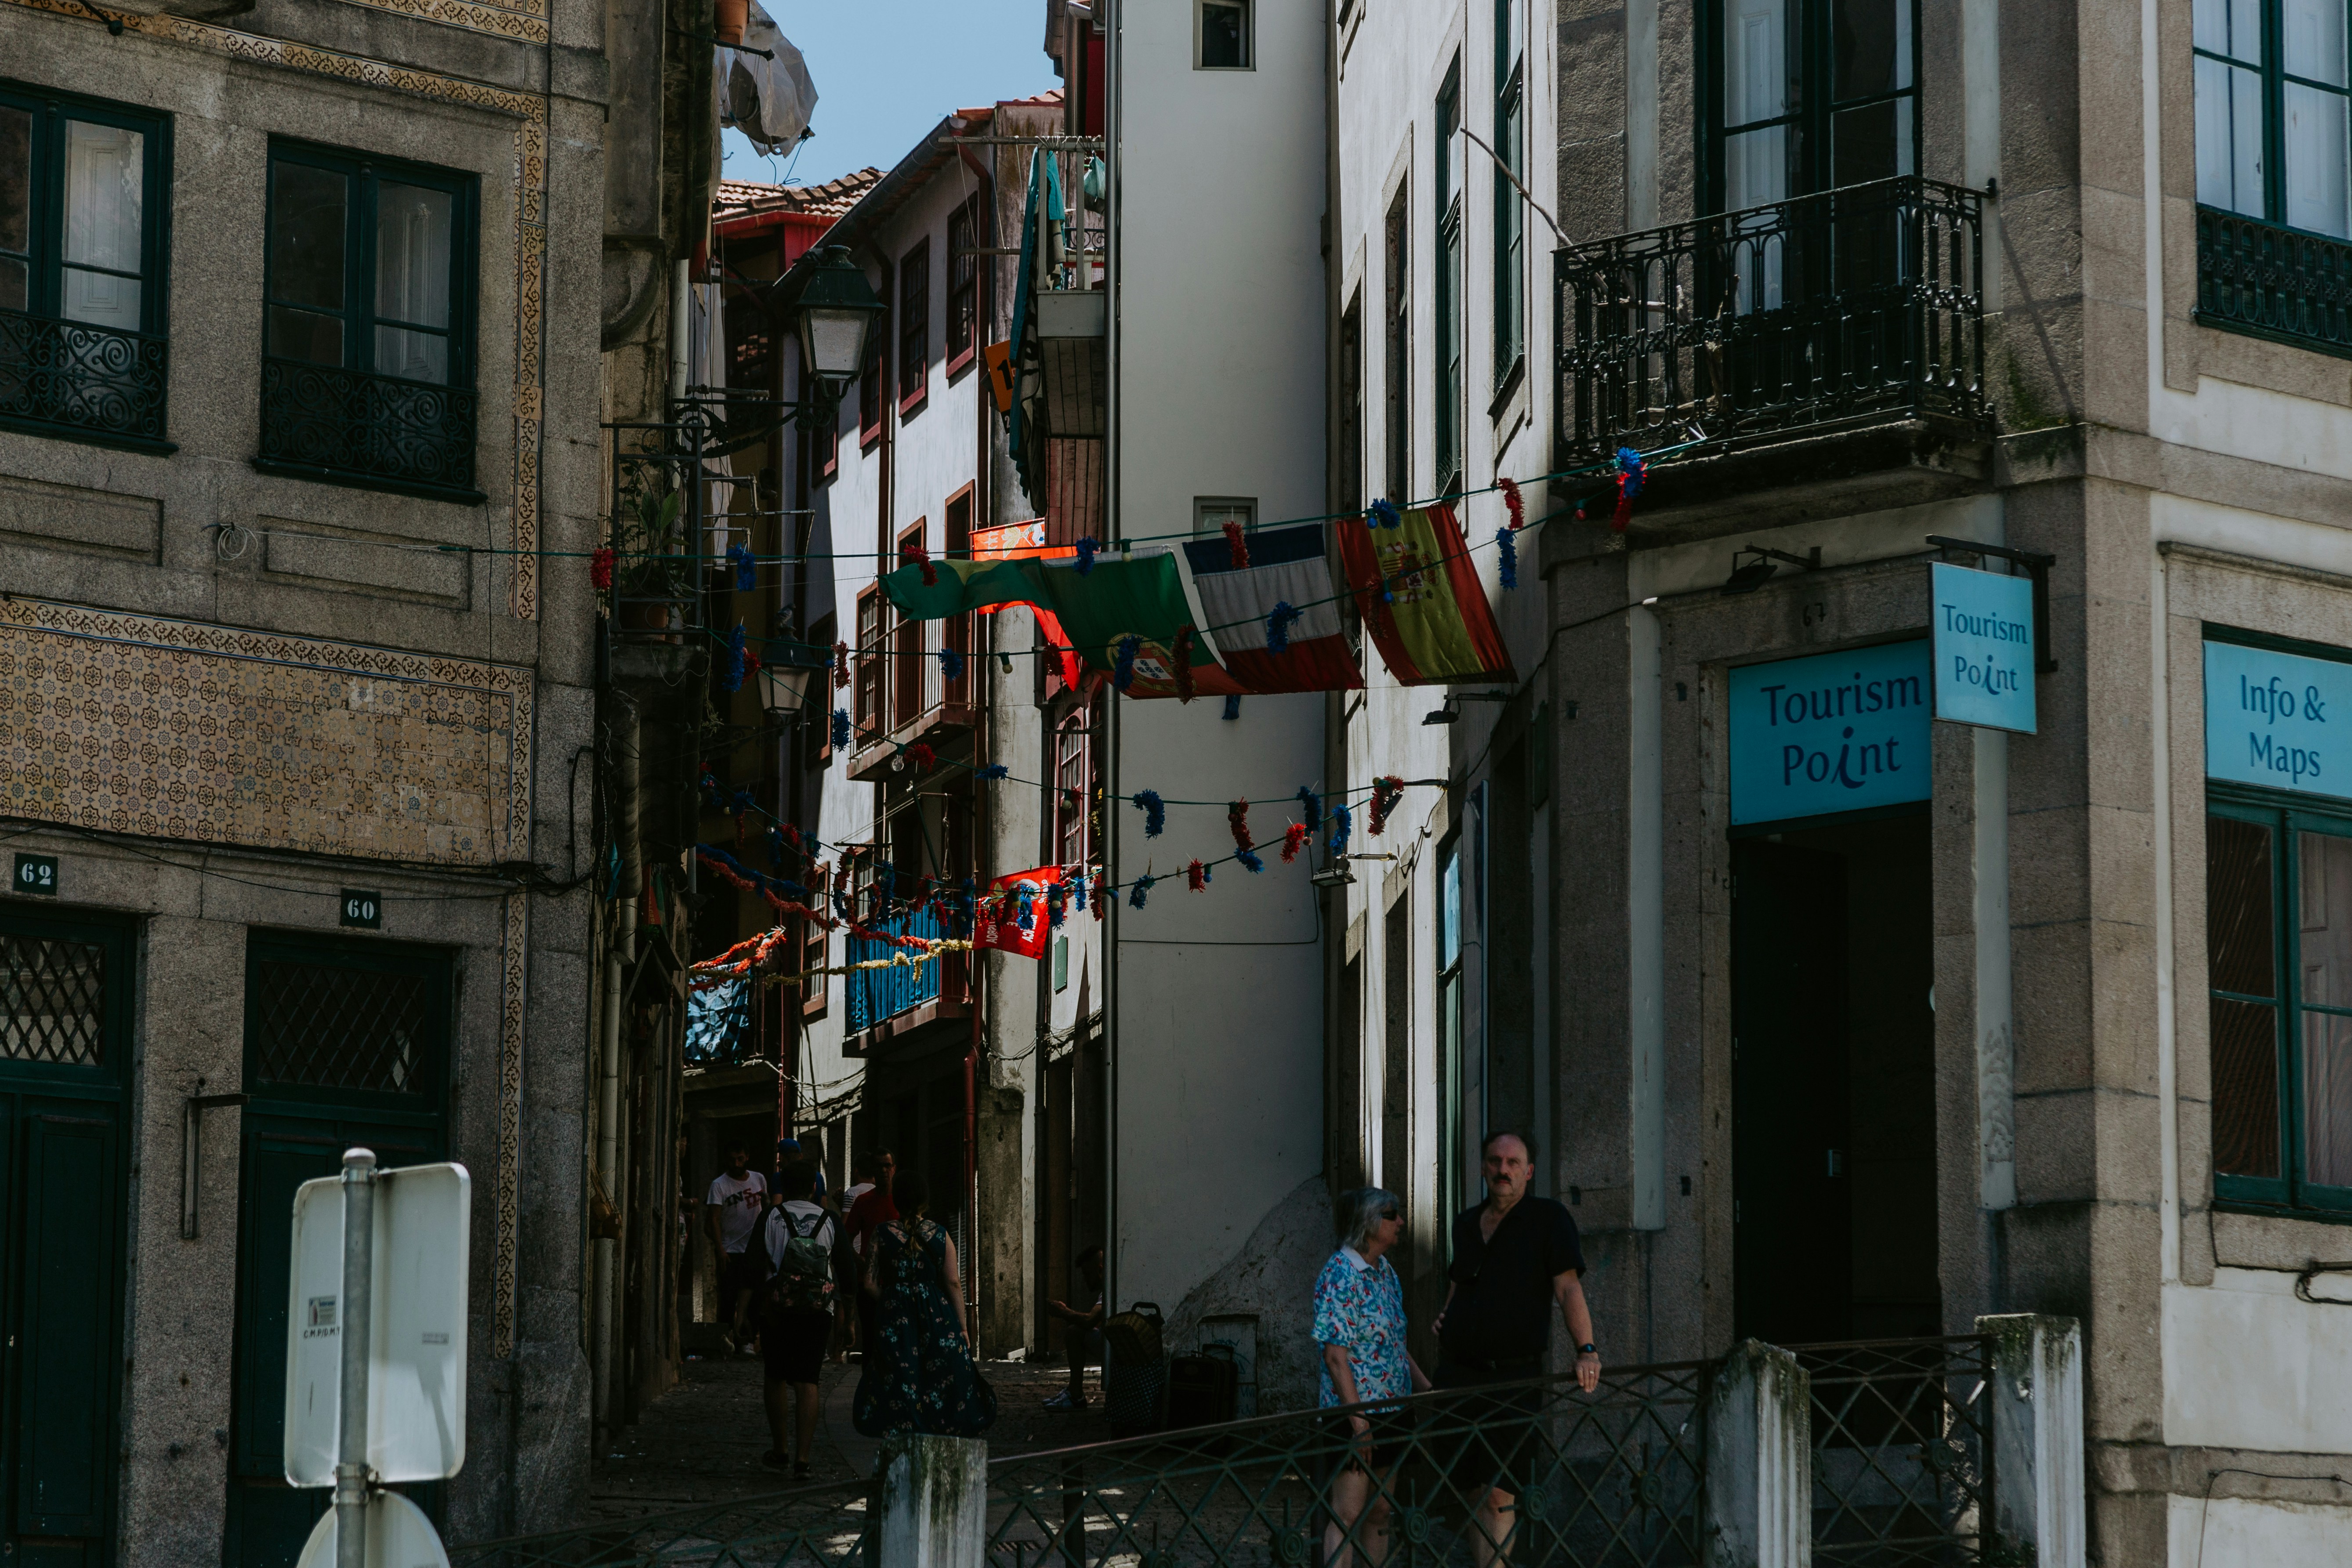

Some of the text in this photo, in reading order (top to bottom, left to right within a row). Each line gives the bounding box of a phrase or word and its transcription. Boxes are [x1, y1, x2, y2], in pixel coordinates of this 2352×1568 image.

[1802, 601, 1827, 627] 67
[1941, 604, 2028, 645] Tourism
[1954, 654, 2019, 696] Point
[1761, 672, 1922, 726] Tourism
[2241, 674, 2326, 725] Info &
[1783, 726, 1902, 789] Point
[2249, 731, 2321, 785] Maps
[22, 863, 51, 885] 62
[347, 899, 375, 919] 60
